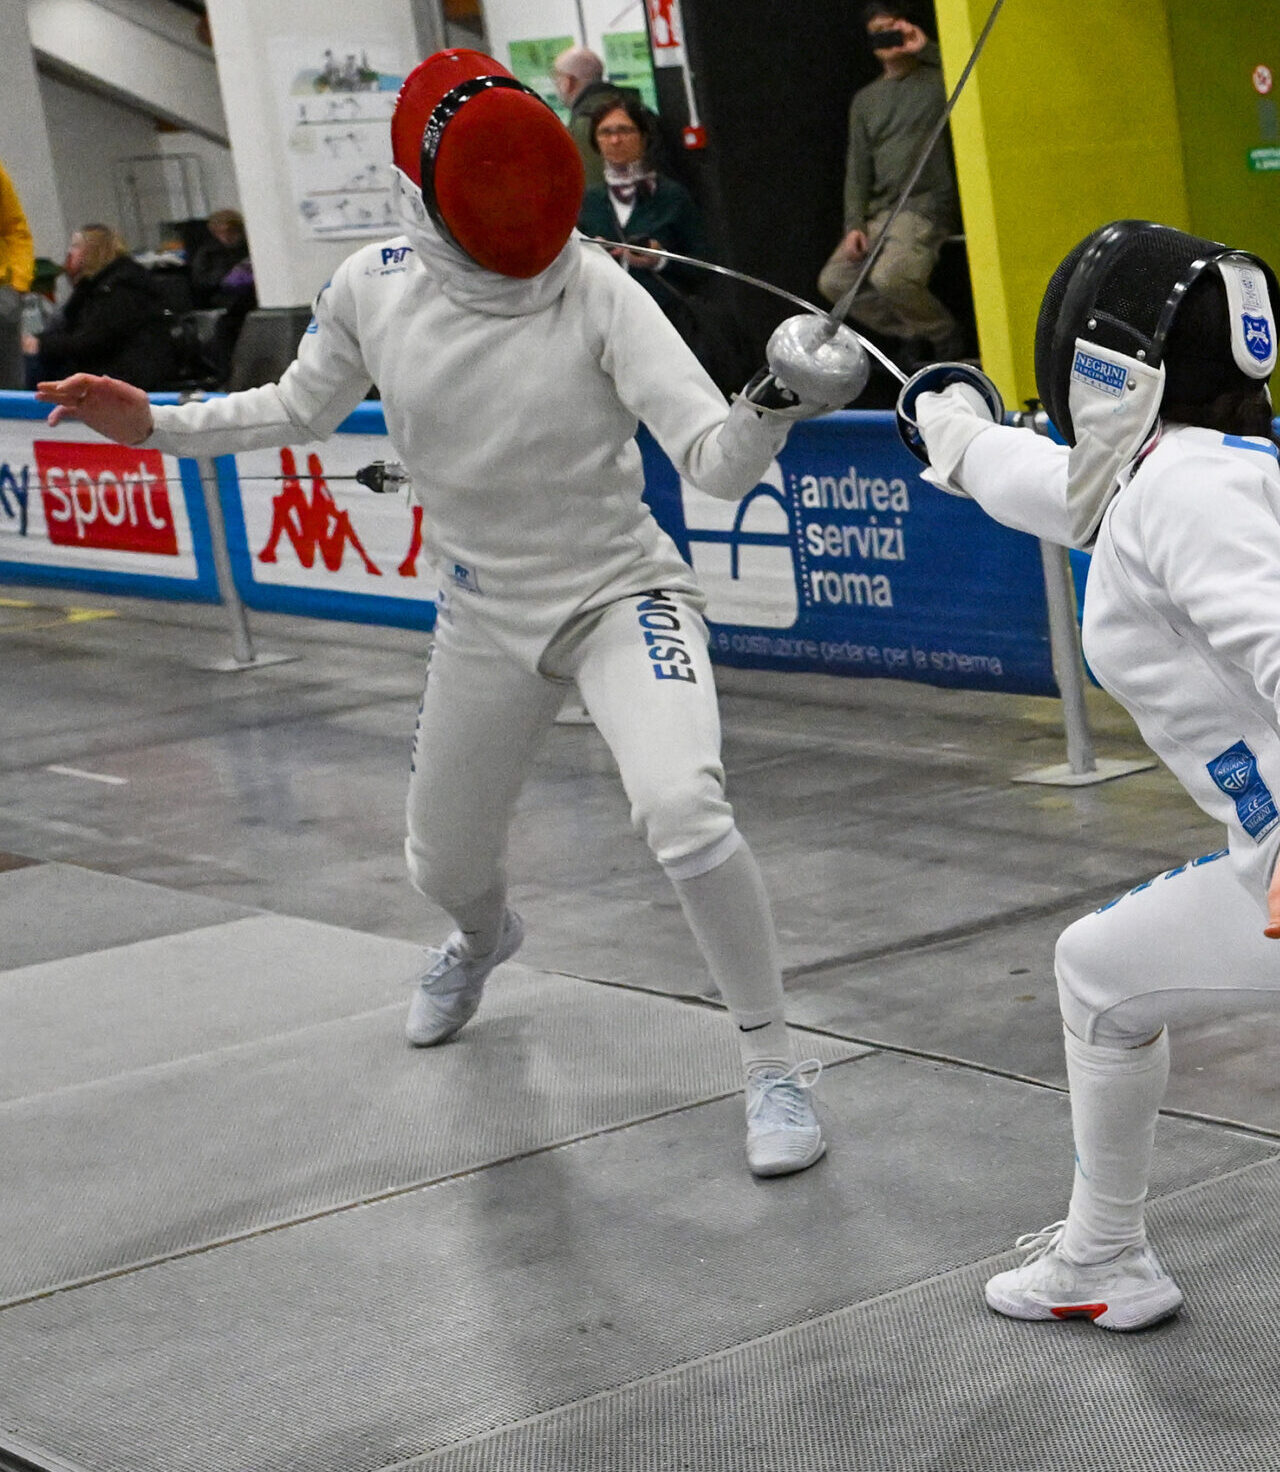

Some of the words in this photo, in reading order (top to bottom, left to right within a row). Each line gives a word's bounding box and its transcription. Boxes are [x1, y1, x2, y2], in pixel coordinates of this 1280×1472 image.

[1077, 353, 1125, 381] NEGRINI
[47, 461, 166, 539] sport
[800, 465, 910, 512] andrea
[806, 515, 905, 561] servizi
[811, 570, 893, 607] roma
